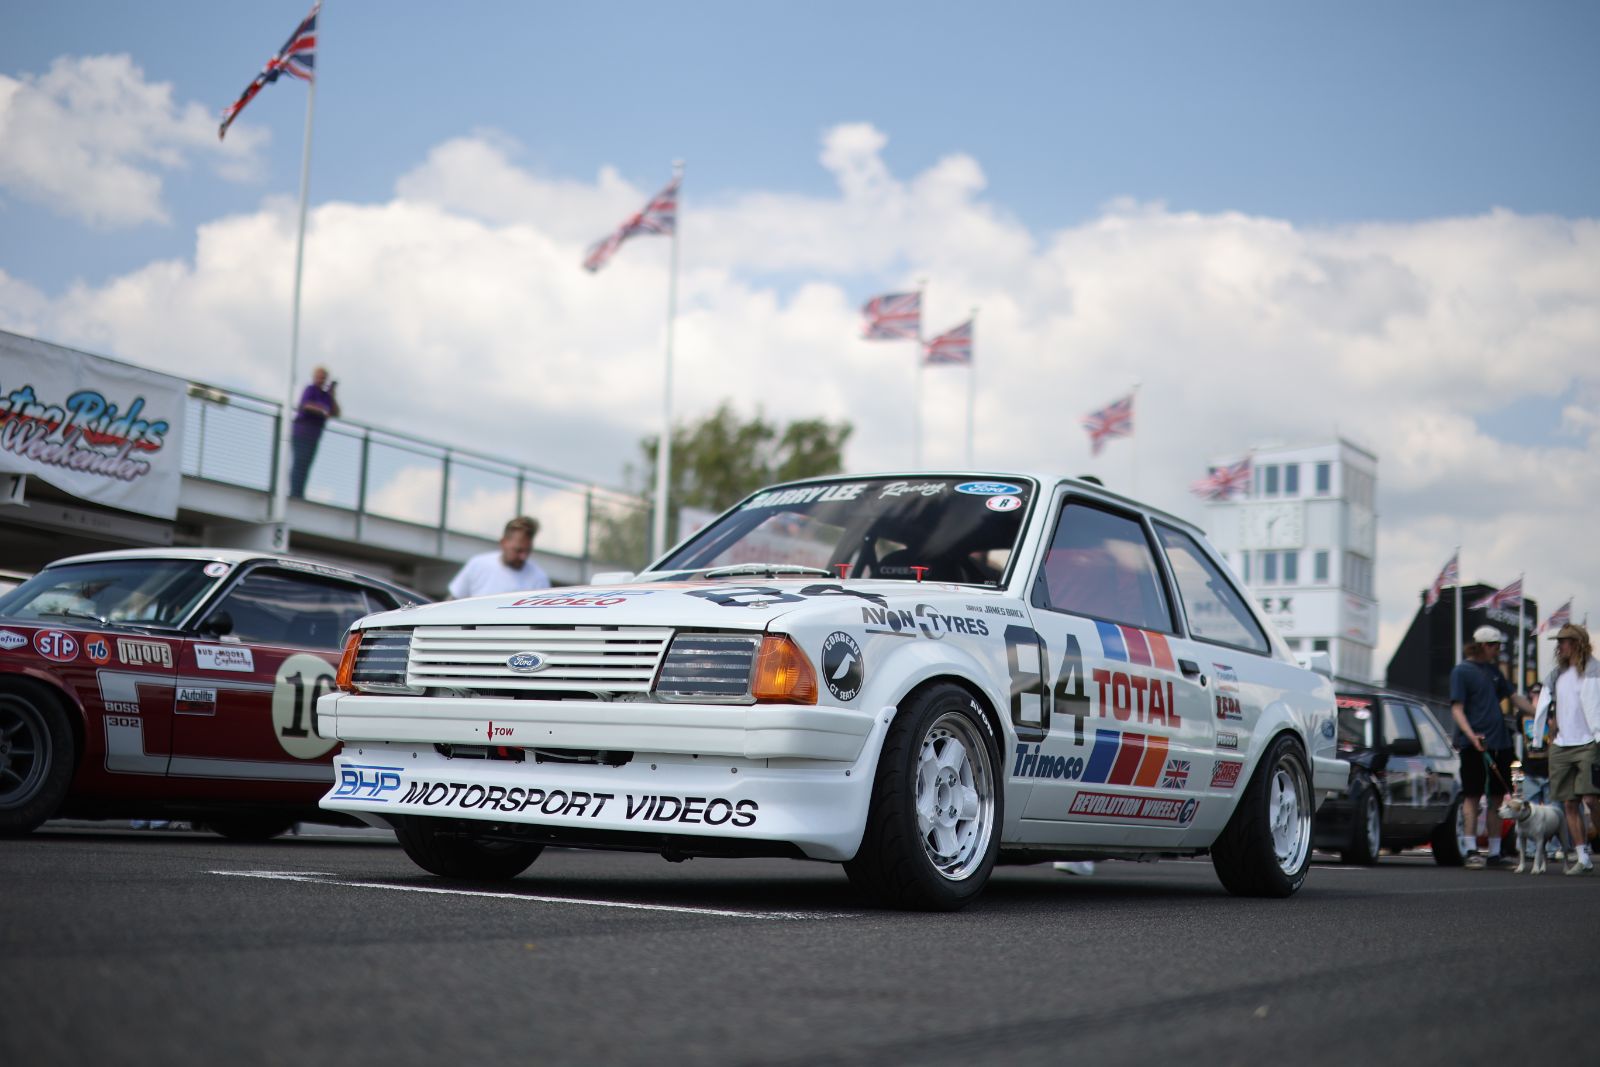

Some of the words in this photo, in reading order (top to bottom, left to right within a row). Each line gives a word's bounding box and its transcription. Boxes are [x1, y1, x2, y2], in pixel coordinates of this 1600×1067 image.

[0, 384, 66, 434] tro
[64, 390, 169, 453] Rides
[2, 417, 151, 482] Weekender
[741, 485, 829, 511] BARRY
[818, 484, 868, 501] LEE
[878, 481, 947, 500] Racing
[968, 483, 1007, 494] Ford
[512, 598, 627, 607] VIDEO
[861, 607, 916, 633] AVON
[927, 613, 989, 636] TYRES
[40, 632, 74, 657] STP
[87, 640, 109, 660] 76
[116, 638, 173, 669] UNIQUE
[218, 650, 245, 658] MOORE
[824, 633, 860, 656] CORBEAU
[513, 655, 534, 667] Ford
[180, 689, 214, 702] Autolite
[829, 683, 839, 695] GT
[840, 688, 856, 701] SEATS
[1003, 624, 1091, 746] 84
[104, 703, 140, 714] BOSS
[1092, 668, 1181, 729] TOTAL
[108, 717, 140, 728] 302
[494, 727, 515, 736] TOW
[1013, 743, 1084, 779] Trimoco
[334, 770, 401, 797] BHP
[399, 781, 615, 817] MOTORSPORT
[625, 794, 759, 827] VIDEOS
[1071, 793, 1143, 816] REVOLUTION
[1141, 799, 1182, 819] WHEELS
